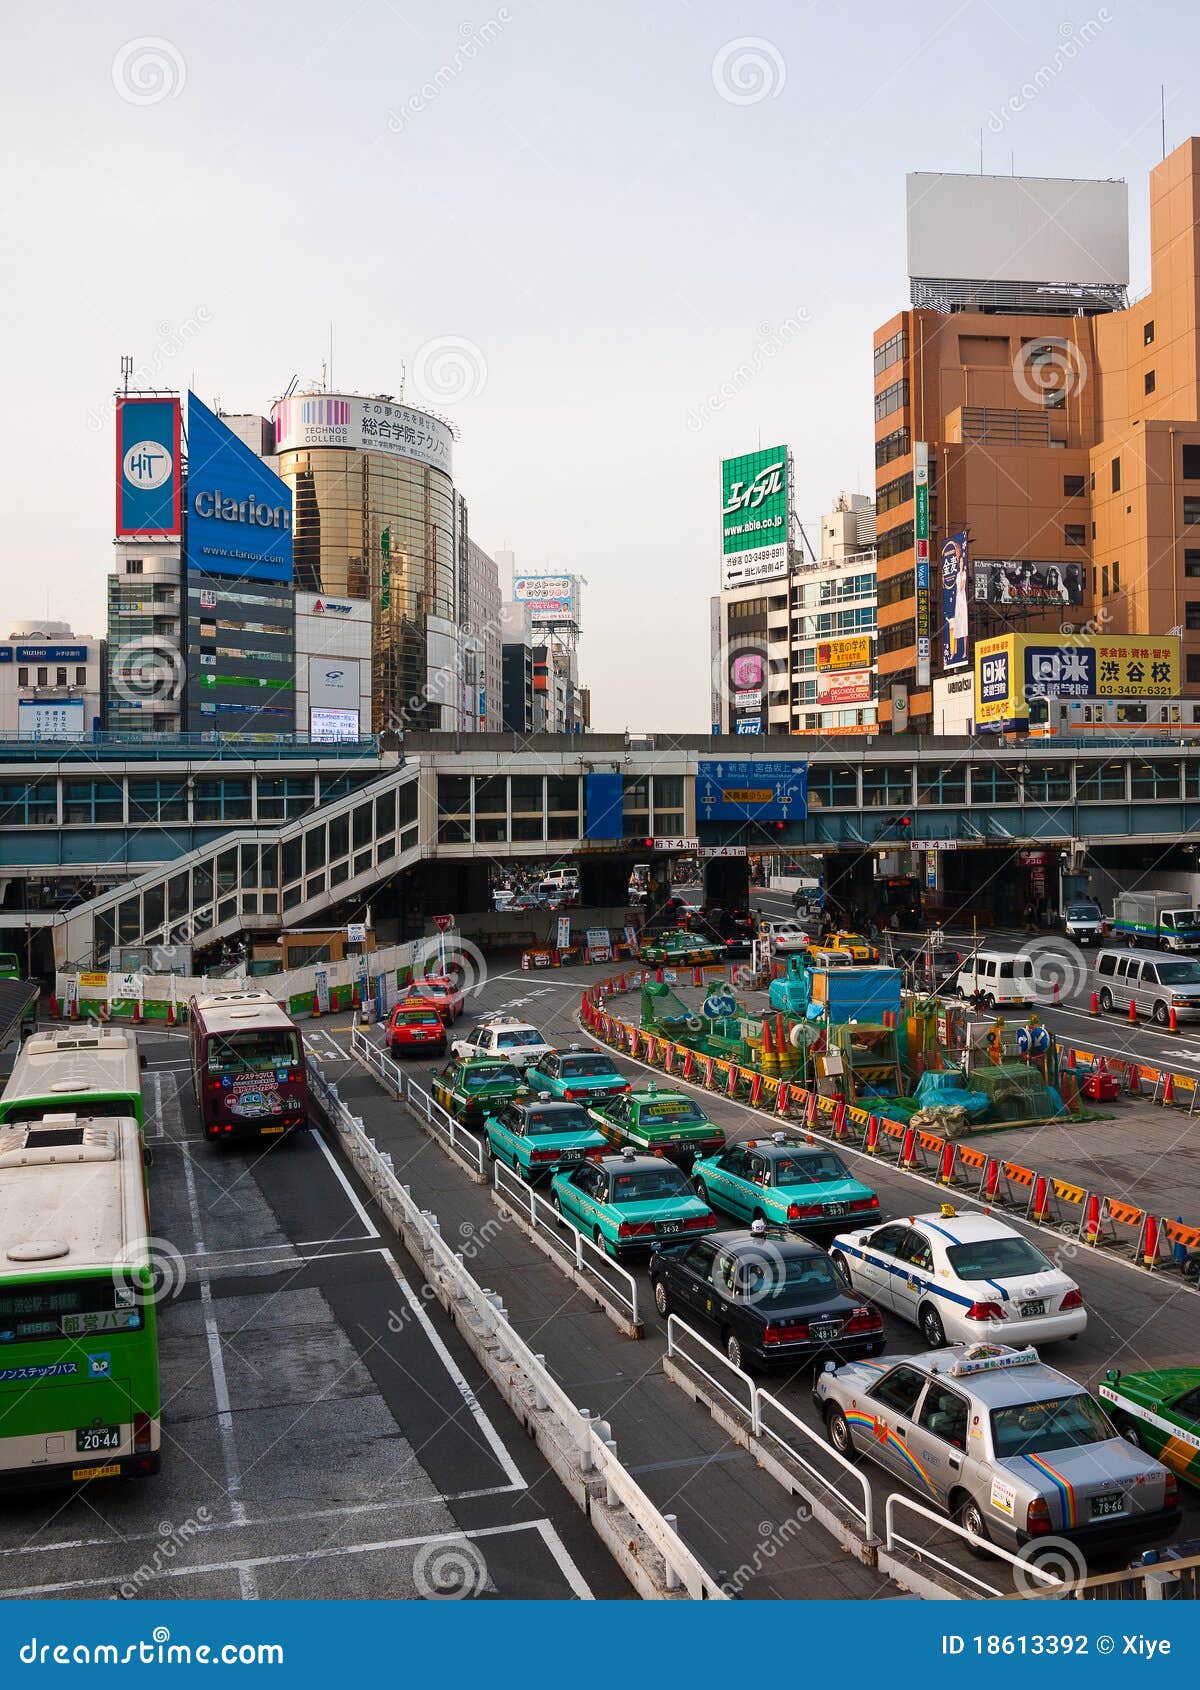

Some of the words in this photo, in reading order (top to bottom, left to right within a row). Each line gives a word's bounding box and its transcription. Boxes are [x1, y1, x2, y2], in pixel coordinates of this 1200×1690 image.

[305, 426, 348, 434] TECHNOS
[305, 435, 348, 443] COLLEGE
[723, 462, 783, 514] エイブル
[194, 489, 289, 529] Clarion
[724, 515, 782, 536] www.able.co.jp
[202, 546, 284, 565] www.clarion.com
[943, 555, 958, 576] 金麦
[832, 640, 867, 654] 写真の学校
[982, 658, 1006, 684] 日米
[1032, 654, 1089, 681] 日米
[1100, 661, 1171, 682] 渋谷校
[947, 678, 972, 694] uematsu
[983, 683, 1006, 697] 英語学院
[1032, 683, 1088, 695] 英語学院
[1100, 685, 1172, 695] 03-3407-6321
[728, 763, 747, 773] 新宿
[676, 840, 698, 848] 4.1m
[932, 841, 956, 849] 4.1m
[720, 847, 745, 856] 4.1m
[0, 1363, 77, 1380] ノンステップバス
[84, 1432, 118, 1449] 20-44
[1147, 1472, 1161, 1480] 107
[1098, 1500, 1122, 1513] 78-66
